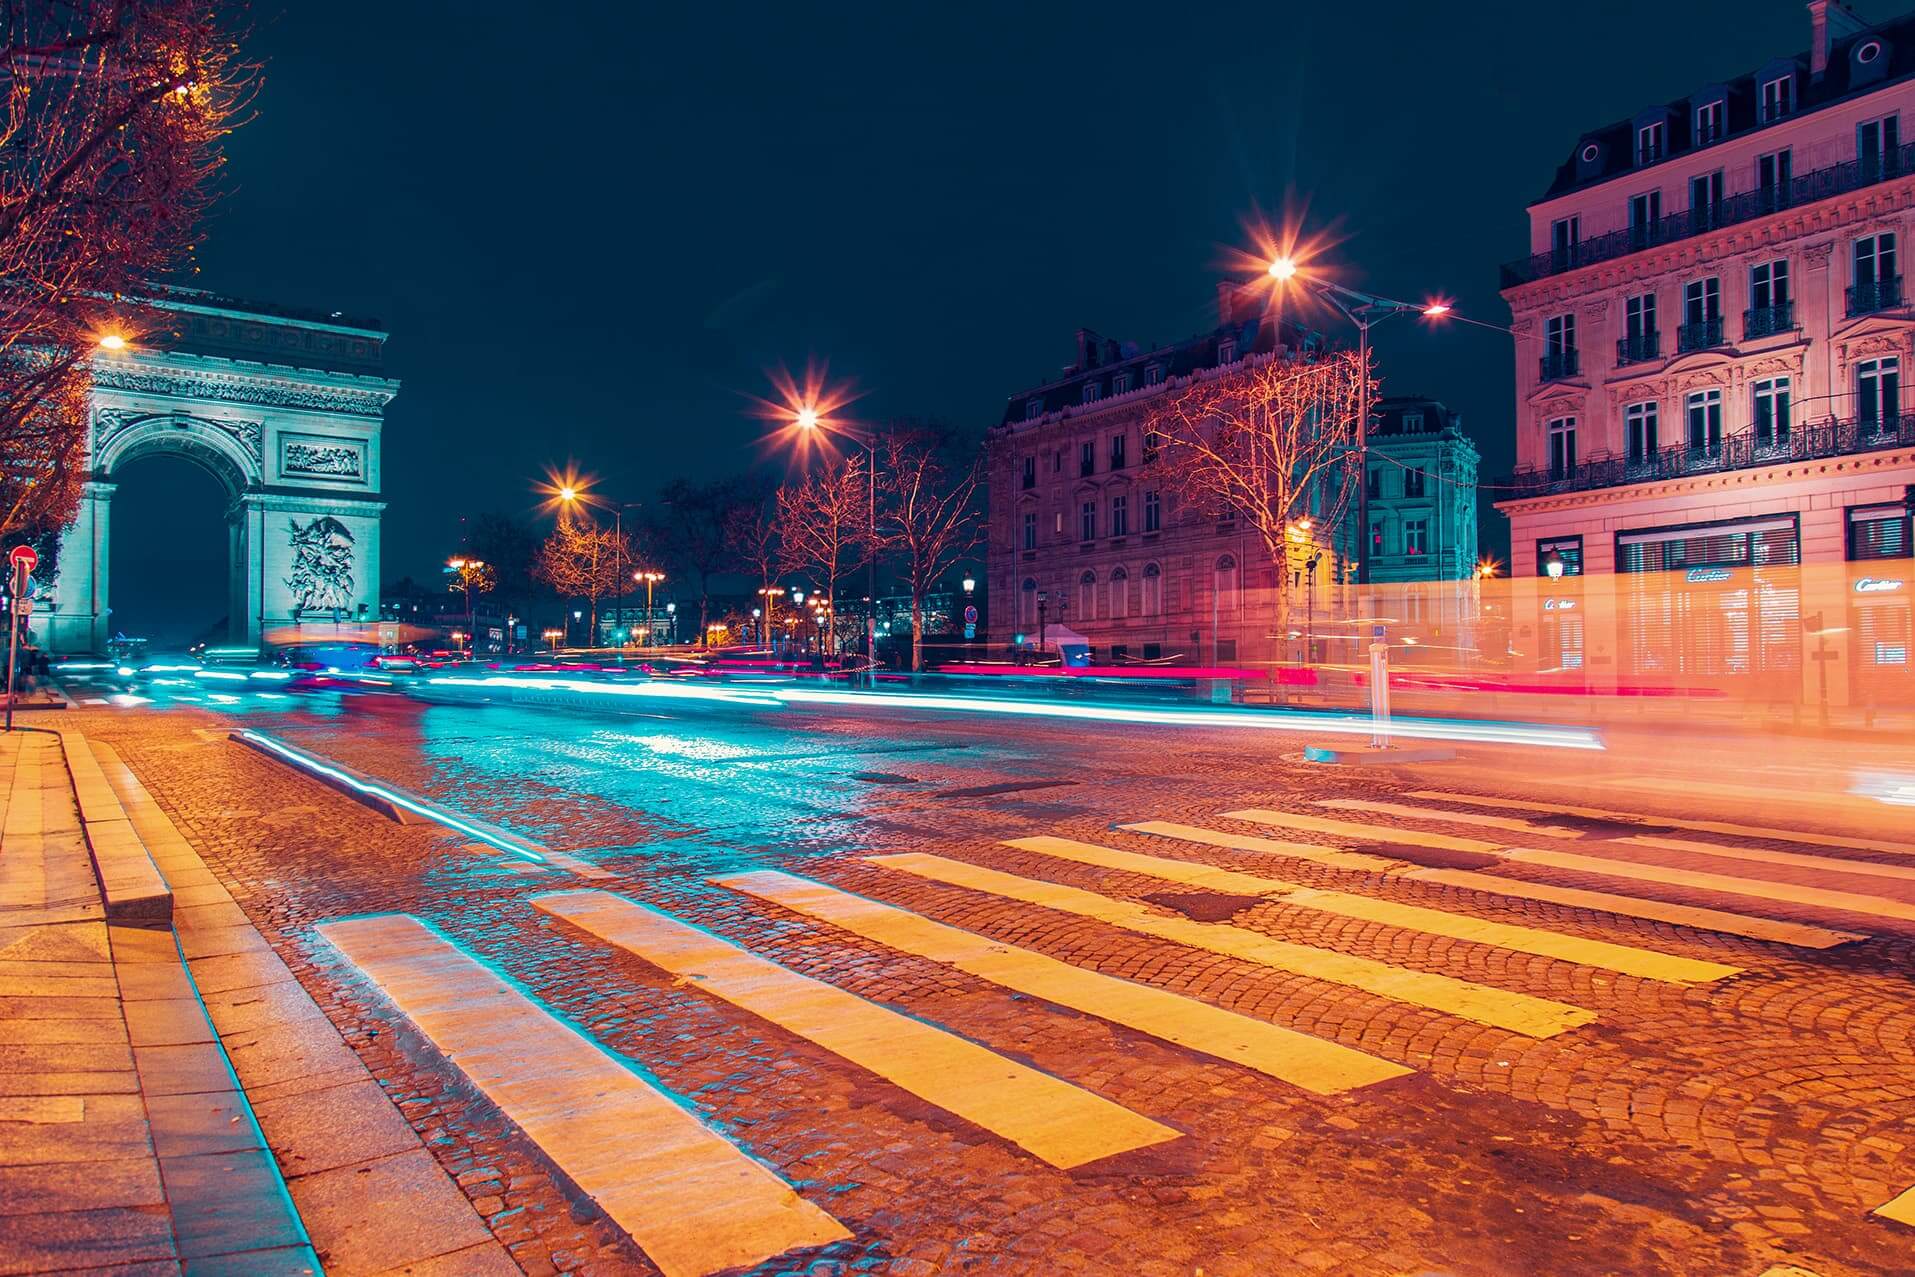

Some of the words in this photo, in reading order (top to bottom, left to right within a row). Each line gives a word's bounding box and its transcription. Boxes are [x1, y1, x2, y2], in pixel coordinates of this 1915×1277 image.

[1687, 568, 1732, 582] Cartier
[1855, 578, 1903, 591] Cartier
[1544, 599, 1576, 609] Ctier
